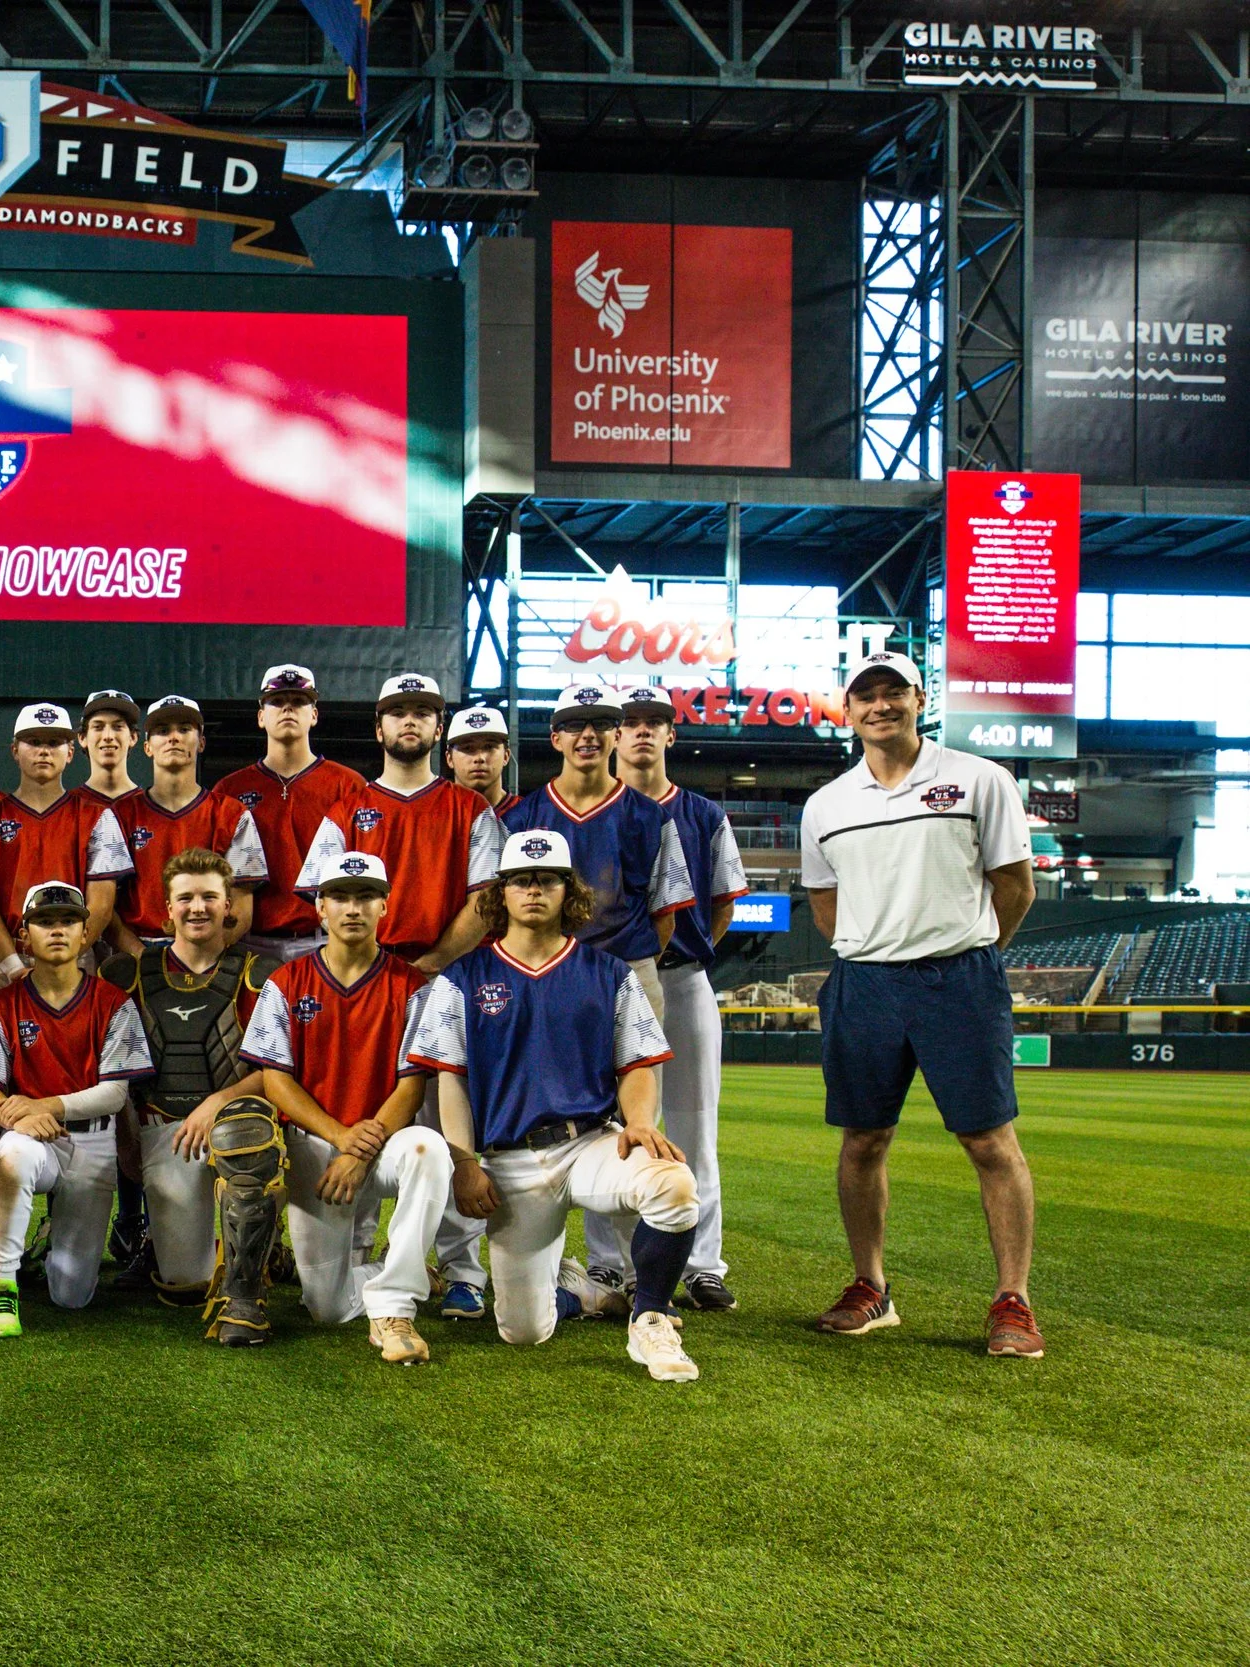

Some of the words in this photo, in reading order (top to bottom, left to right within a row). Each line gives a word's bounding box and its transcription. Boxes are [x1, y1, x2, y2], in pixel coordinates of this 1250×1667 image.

[904, 22, 986, 49] GILA
[993, 25, 1096, 51] RIVER
[905, 53, 982, 67] HOTELS
[990, 56, 1002, 68] &
[1011, 56, 1097, 69] CASINOS
[56, 139, 259, 195] FIELD
[1046, 318, 1121, 342] GILA
[1127, 321, 1227, 346] RIVER
[574, 347, 719, 384] University
[1045, 349, 1115, 360] HOTELS
[1147, 352, 1227, 363] CASINOS
[574, 384, 606, 410] of
[613, 387, 725, 414] Phoenix
[1100, 389, 1118, 398] wild
[1181, 392, 1200, 401] lone
[1202, 393, 1226, 402] butte
[573, 421, 691, 442] Phoenix.edu
[563, 598, 737, 667] Coors
[741, 686, 850, 728] ZON
[968, 724, 1016, 747] 4:00
[1021, 725, 1053, 747] PM
[1029, 803, 1076, 819] TNESS
[1131, 1044, 1175, 1062] 376
